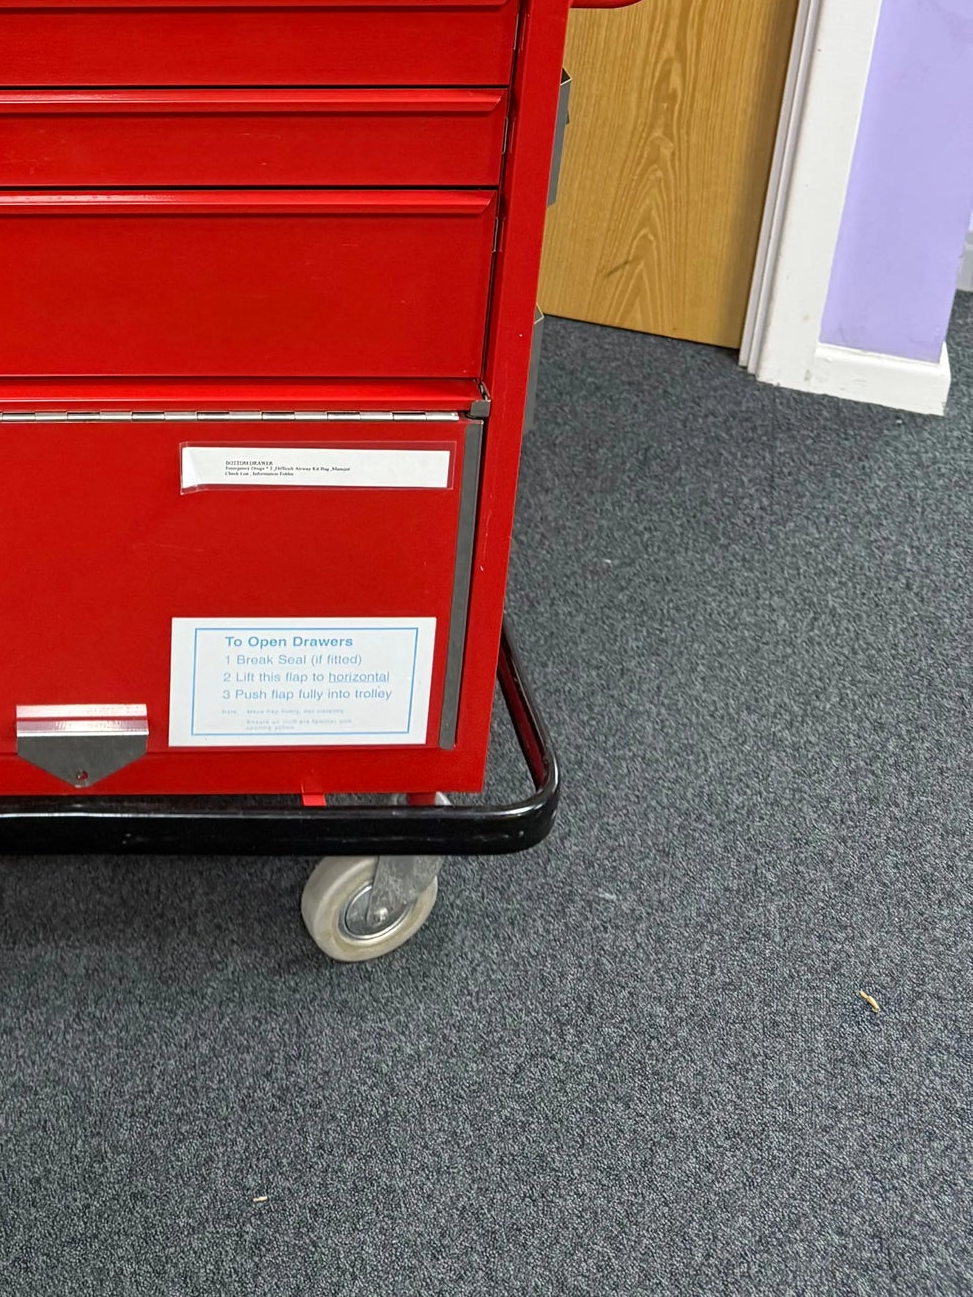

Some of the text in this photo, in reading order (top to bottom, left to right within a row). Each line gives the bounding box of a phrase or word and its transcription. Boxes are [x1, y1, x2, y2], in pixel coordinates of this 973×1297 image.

[225, 636, 354, 650] To Open Drawers
[236, 654, 274, 665] Break
[278, 654, 307, 665] Seal
[311, 654, 323, 667] (if
[327, 654, 363, 667] fitted)
[223, 671, 391, 685] 2 Lift this flap to horizontal
[222, 688, 393, 702] 3 Push flap fully into trolley
